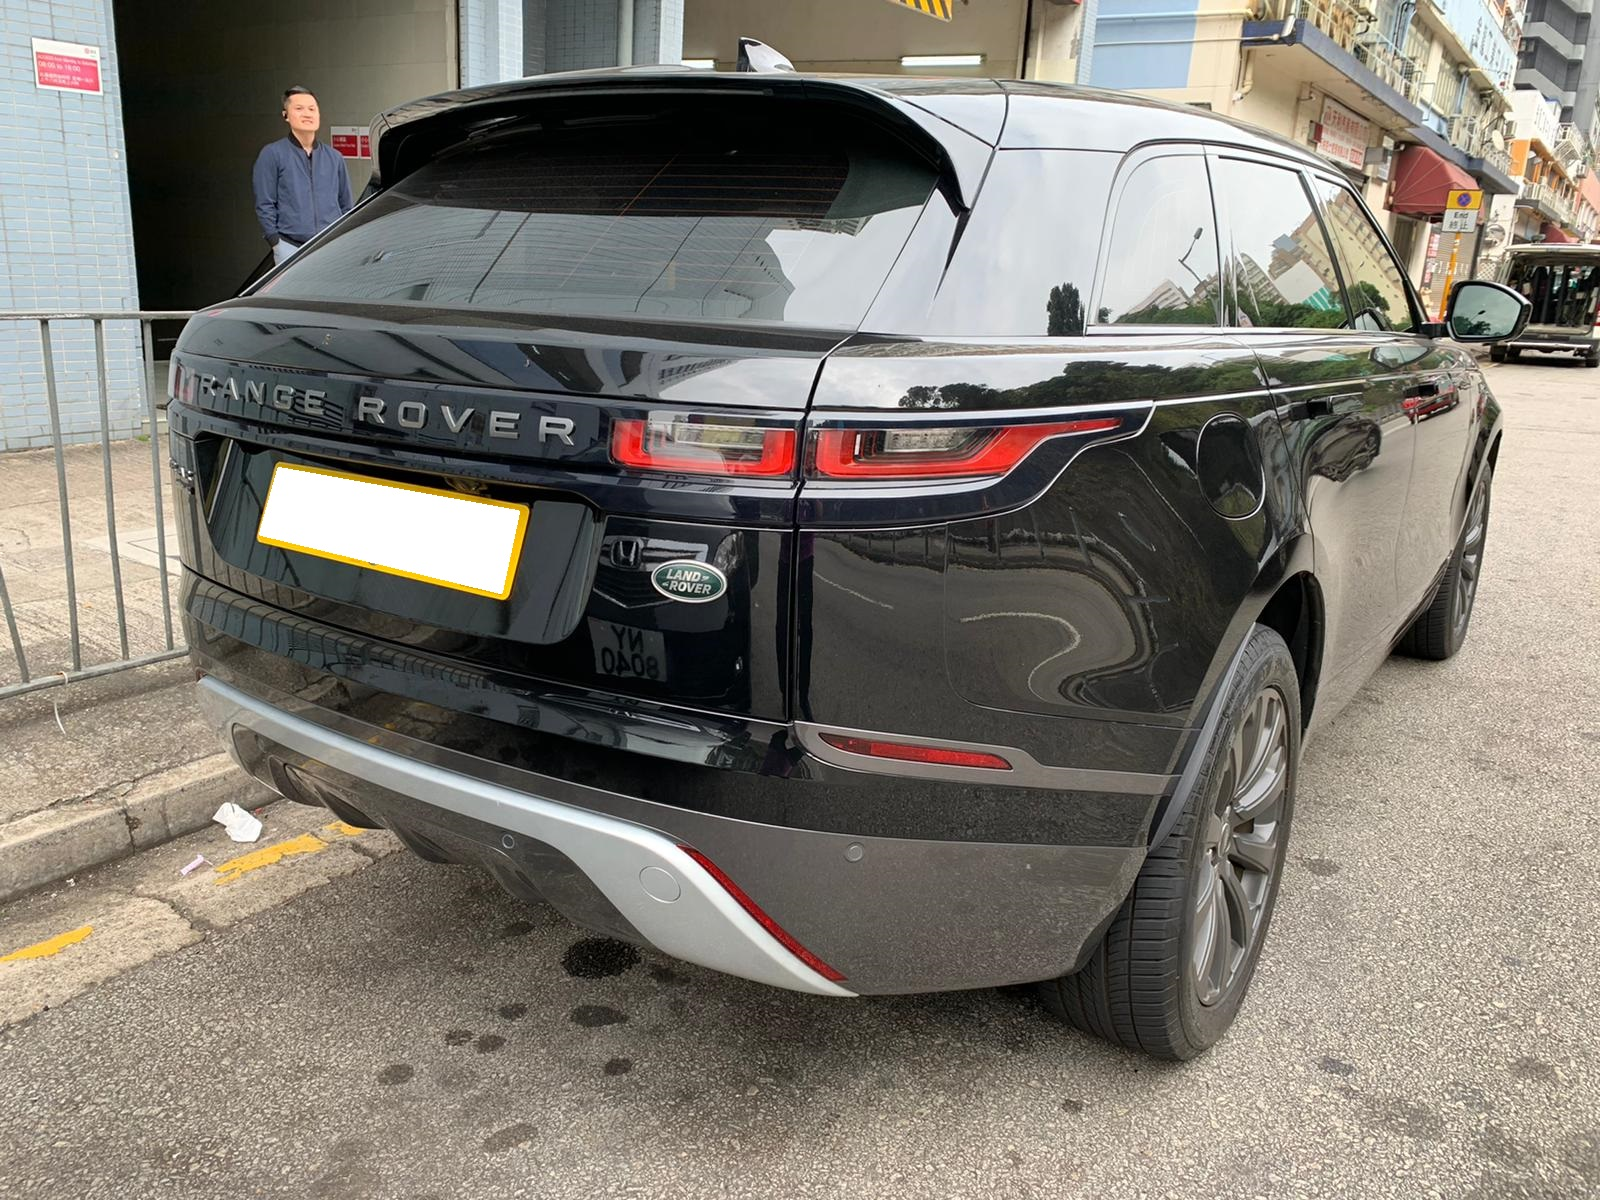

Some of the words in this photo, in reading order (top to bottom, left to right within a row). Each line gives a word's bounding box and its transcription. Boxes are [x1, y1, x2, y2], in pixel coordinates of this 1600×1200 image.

[1454, 211, 1469, 219] End
[1449, 221, 1469, 230] 終止
[201, 372, 329, 417] RANGE
[358, 396, 576, 447] ROVER
[666, 568, 701, 582] LAND
[668, 581, 712, 595] ROVER
